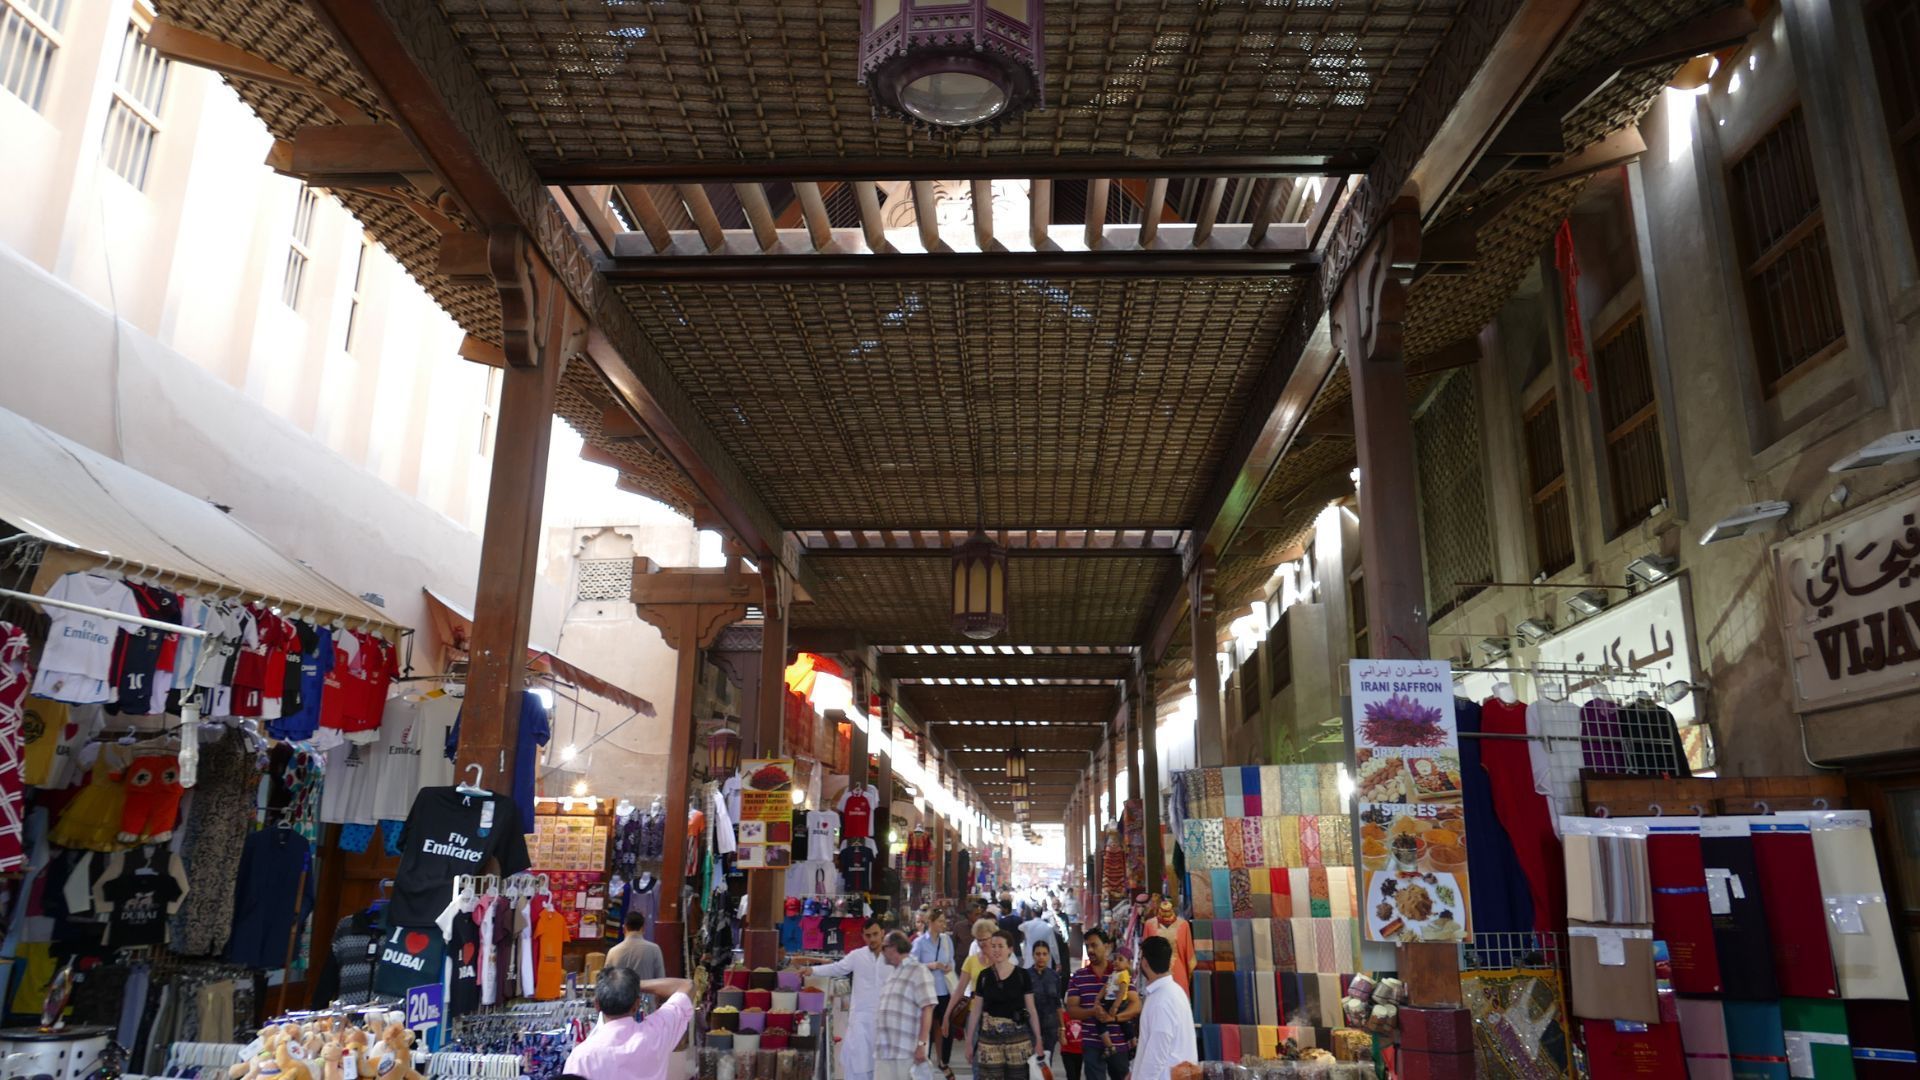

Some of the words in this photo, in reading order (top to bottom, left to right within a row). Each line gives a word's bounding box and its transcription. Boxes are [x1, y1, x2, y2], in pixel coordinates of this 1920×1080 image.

[63, 626, 109, 645] Emirates
[1360, 681, 1390, 692] IRANI
[1393, 681, 1442, 693] SAFFRON
[1372, 747, 1397, 758] DRY
[1400, 747, 1440, 759] FRUITS
[1381, 803, 1437, 817] SPICES
[448, 832, 468, 847] Fly
[422, 838, 483, 862] Emirates
[389, 926, 404, 944] I
[382, 948, 425, 971] DUBAI
[409, 992, 428, 1023] 20
